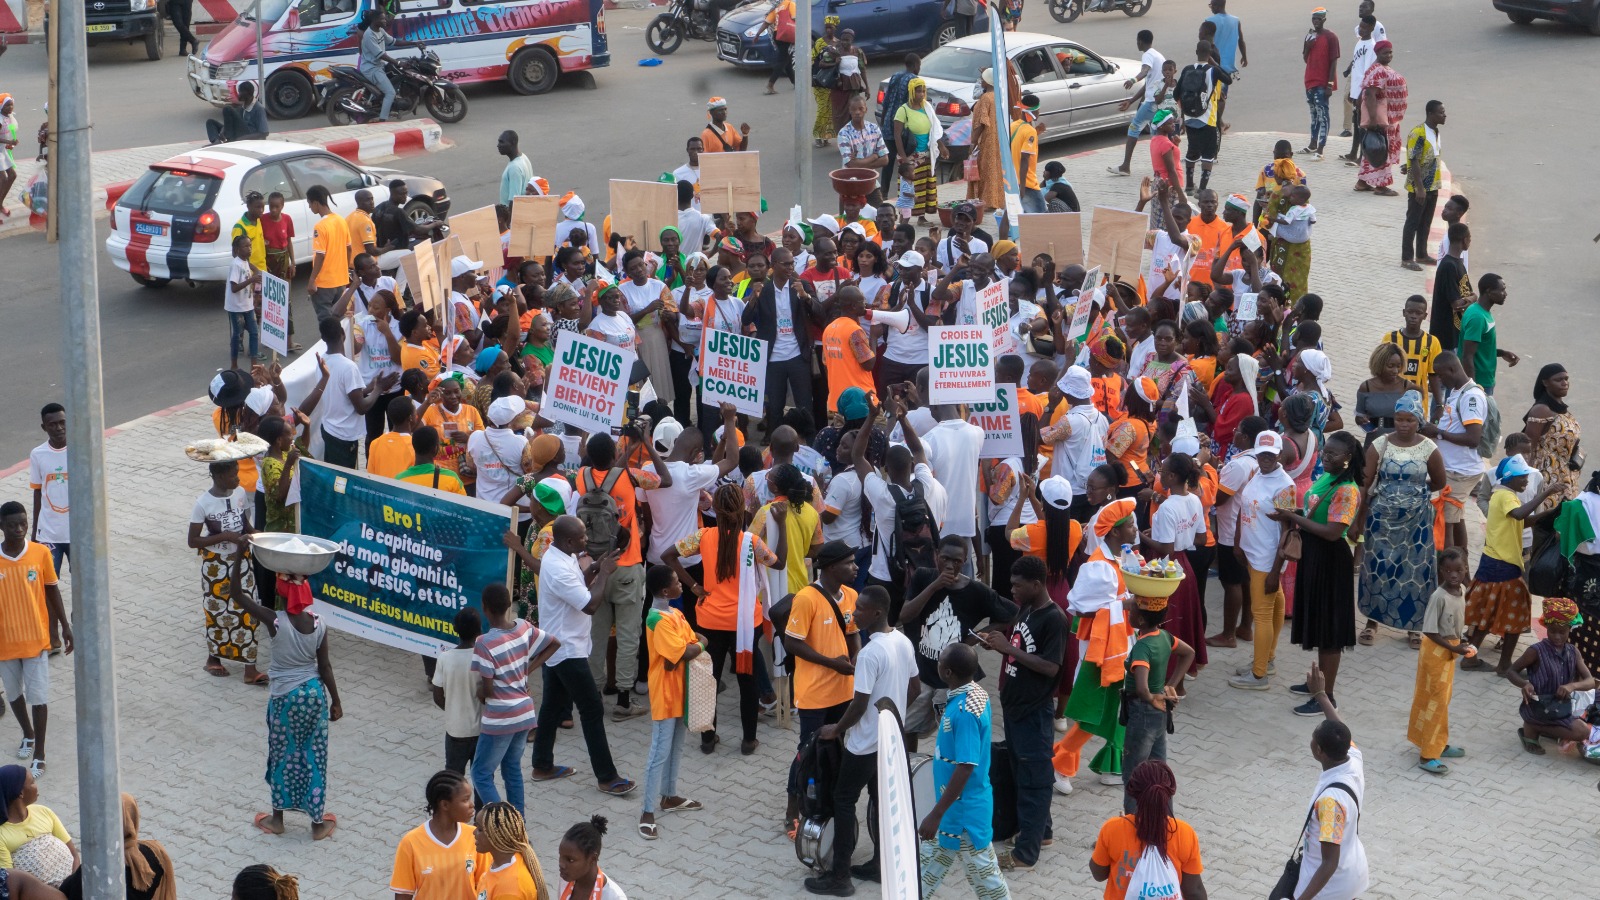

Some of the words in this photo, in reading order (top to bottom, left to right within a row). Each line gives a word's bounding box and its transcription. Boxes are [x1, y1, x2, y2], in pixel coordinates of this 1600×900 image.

[263, 276, 286, 307] JESUS
[983, 283, 1002, 298] DONNE
[983, 300, 991, 310] TA
[991, 295, 999, 306] VIE
[264, 310, 285, 328] MEILLEUR
[268, 301, 276, 312] EST
[276, 306, 282, 315] LE
[982, 302, 1008, 329] JESUS
[941, 331, 969, 340] CROIS
[971, 331, 982, 339] EN
[994, 324, 1009, 337] SERAS
[708, 331, 761, 362] JESUS
[933, 343, 989, 368] JESUS
[562, 340, 623, 380] JESUS
[718, 356, 736, 370] EST
[738, 361, 749, 373] LE
[1408, 362, 1418, 372] &1
[559, 366, 618, 396] REVIENT
[708, 366, 757, 386] MEILLEUR
[934, 380, 992, 389] ÉTERNELLEMENT
[939, 371, 947, 379] ET
[959, 370, 987, 378] VIVRAS
[554, 384, 615, 415] BIENTÔT
[705, 378, 758, 403] COACH
[553, 401, 577, 415] DONNE
[579, 408, 589, 418] LUI
[591, 412, 599, 421] TA
[601, 416, 611, 425] VIE
[383, 504, 413, 529] Bro
[415, 512, 422, 532] !
[361, 523, 375, 541] le
[376, 531, 443, 562] capitaine
[338, 539, 356, 557] de
[357, 547, 389, 568] mon
[391, 555, 441, 585] gbonhi
[442, 569, 463, 593] là,
[334, 560, 368, 583] c'est
[369, 570, 416, 601] JESUS,
[417, 586, 433, 604] et
[434, 589, 457, 610] toi
[458, 595, 468, 610] ?
[321, 582, 368, 609] ACCEPTE
[368, 597, 401, 620] JÉSUS
